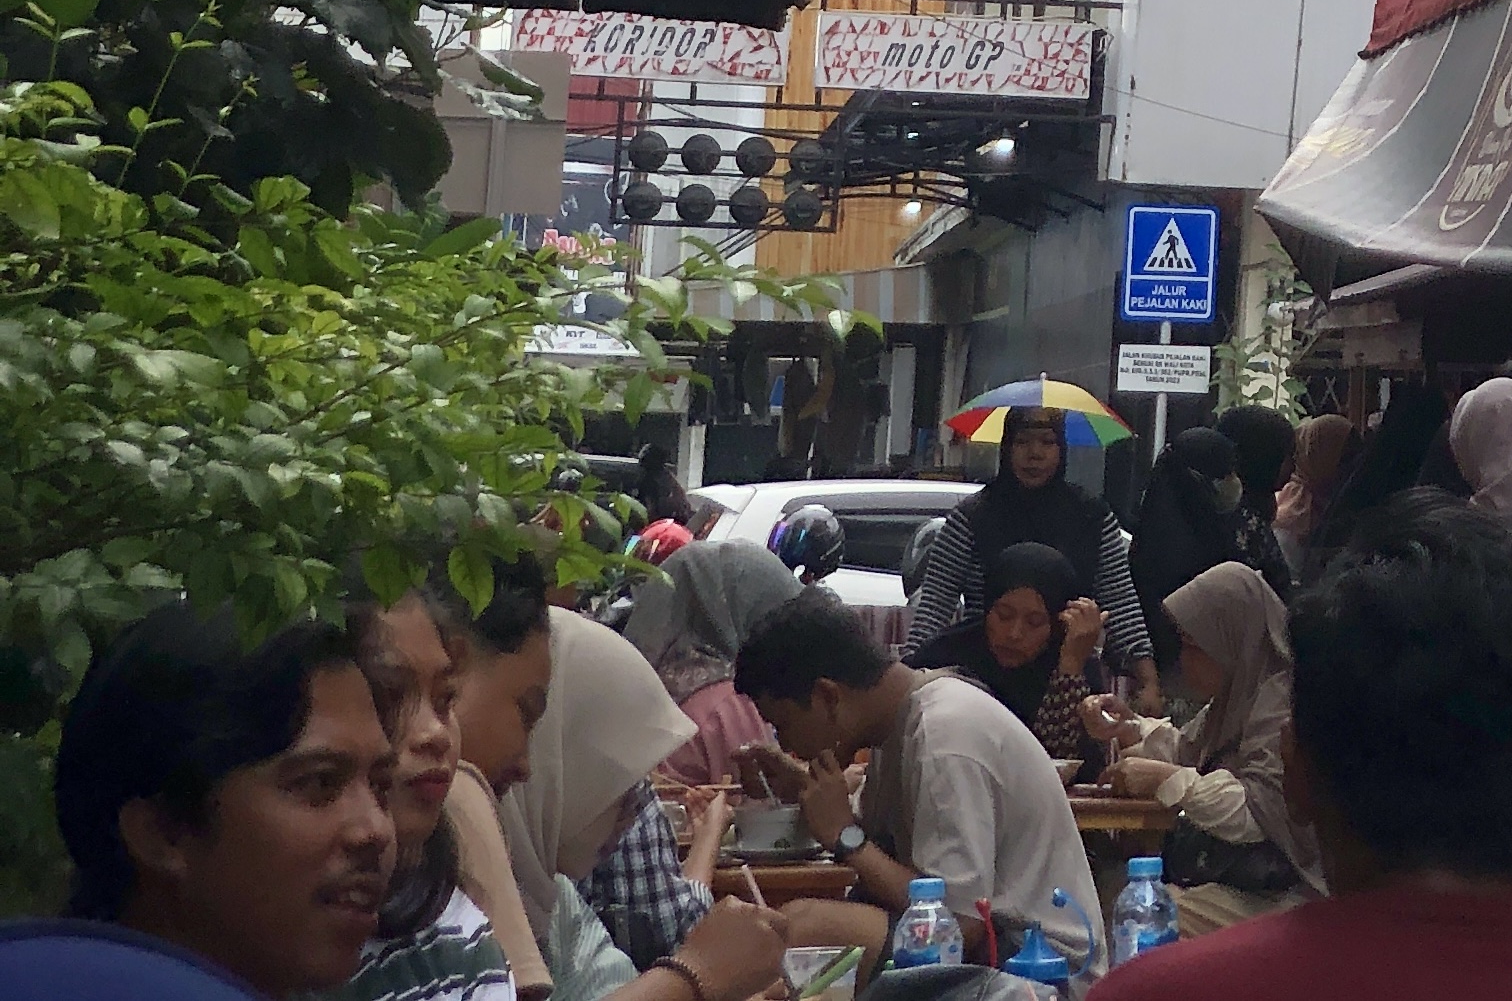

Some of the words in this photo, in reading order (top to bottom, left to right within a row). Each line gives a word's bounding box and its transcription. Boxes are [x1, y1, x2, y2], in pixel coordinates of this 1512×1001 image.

[582, 22, 717, 59] KORIDOR
[881, 39, 956, 69] moto
[965, 40, 1005, 71] GP
[1152, 284, 1186, 296] JALUR
[1130, 296, 1178, 308] PEJALAN
[1182, 298, 1208, 310] KAKI
